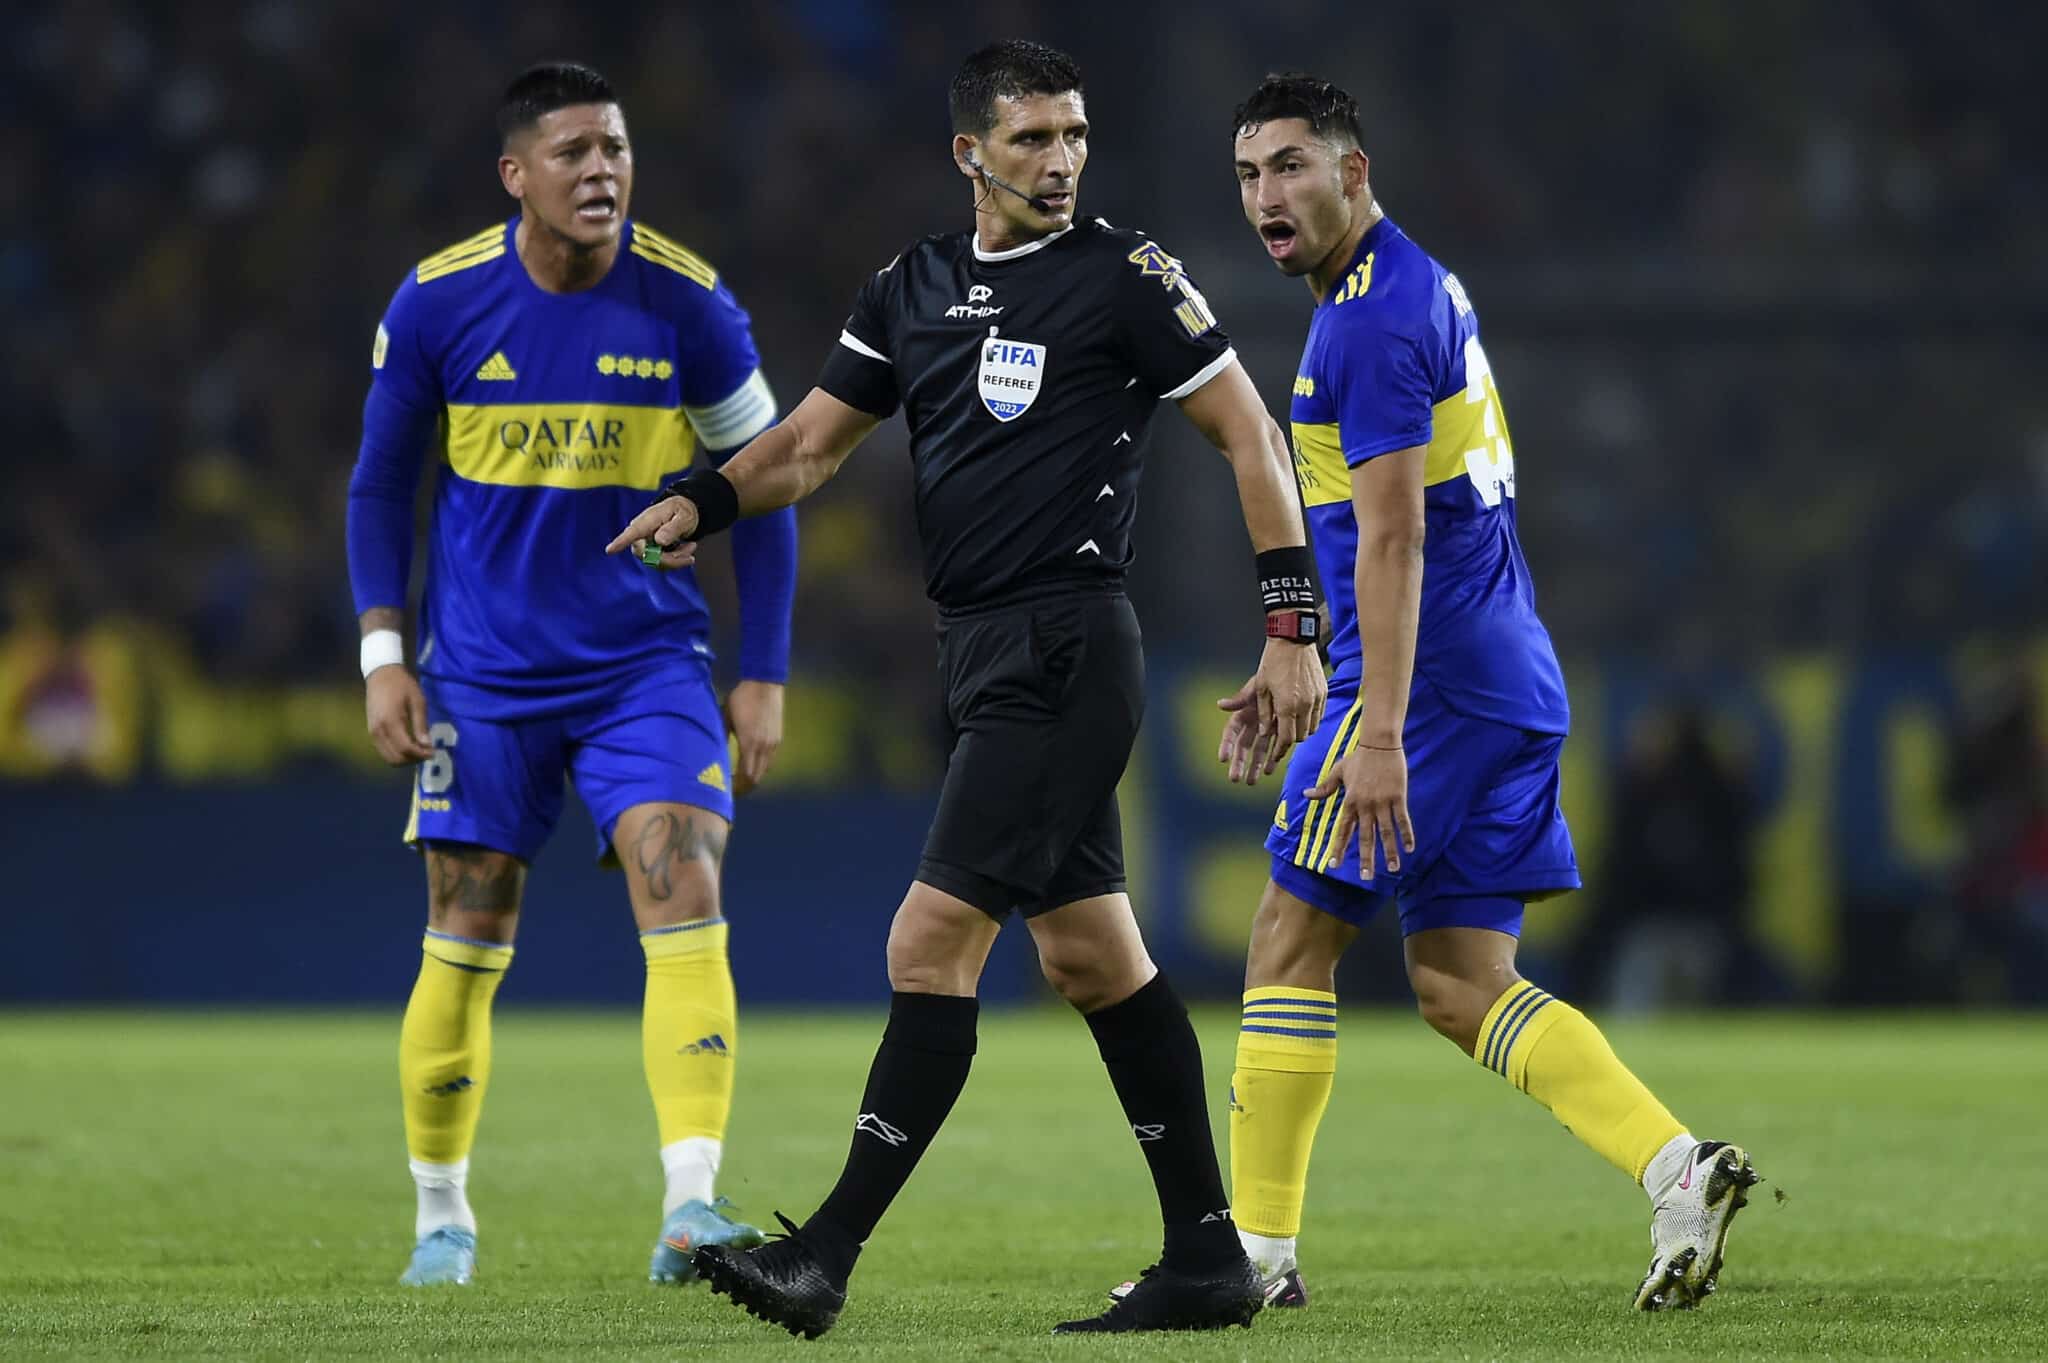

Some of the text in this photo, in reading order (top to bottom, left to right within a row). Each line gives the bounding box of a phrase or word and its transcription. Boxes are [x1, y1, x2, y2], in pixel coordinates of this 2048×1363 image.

[945, 305, 1004, 318] ATHIX
[984, 374, 1035, 390] REFEREE
[993, 402, 1017, 414] 2022
[500, 418, 624, 455] QATAR
[532, 451, 620, 472] AIRWAYS
[1261, 577, 1311, 592] REGLA
[1281, 591, 1298, 602] 18
[421, 722, 458, 793] 6
